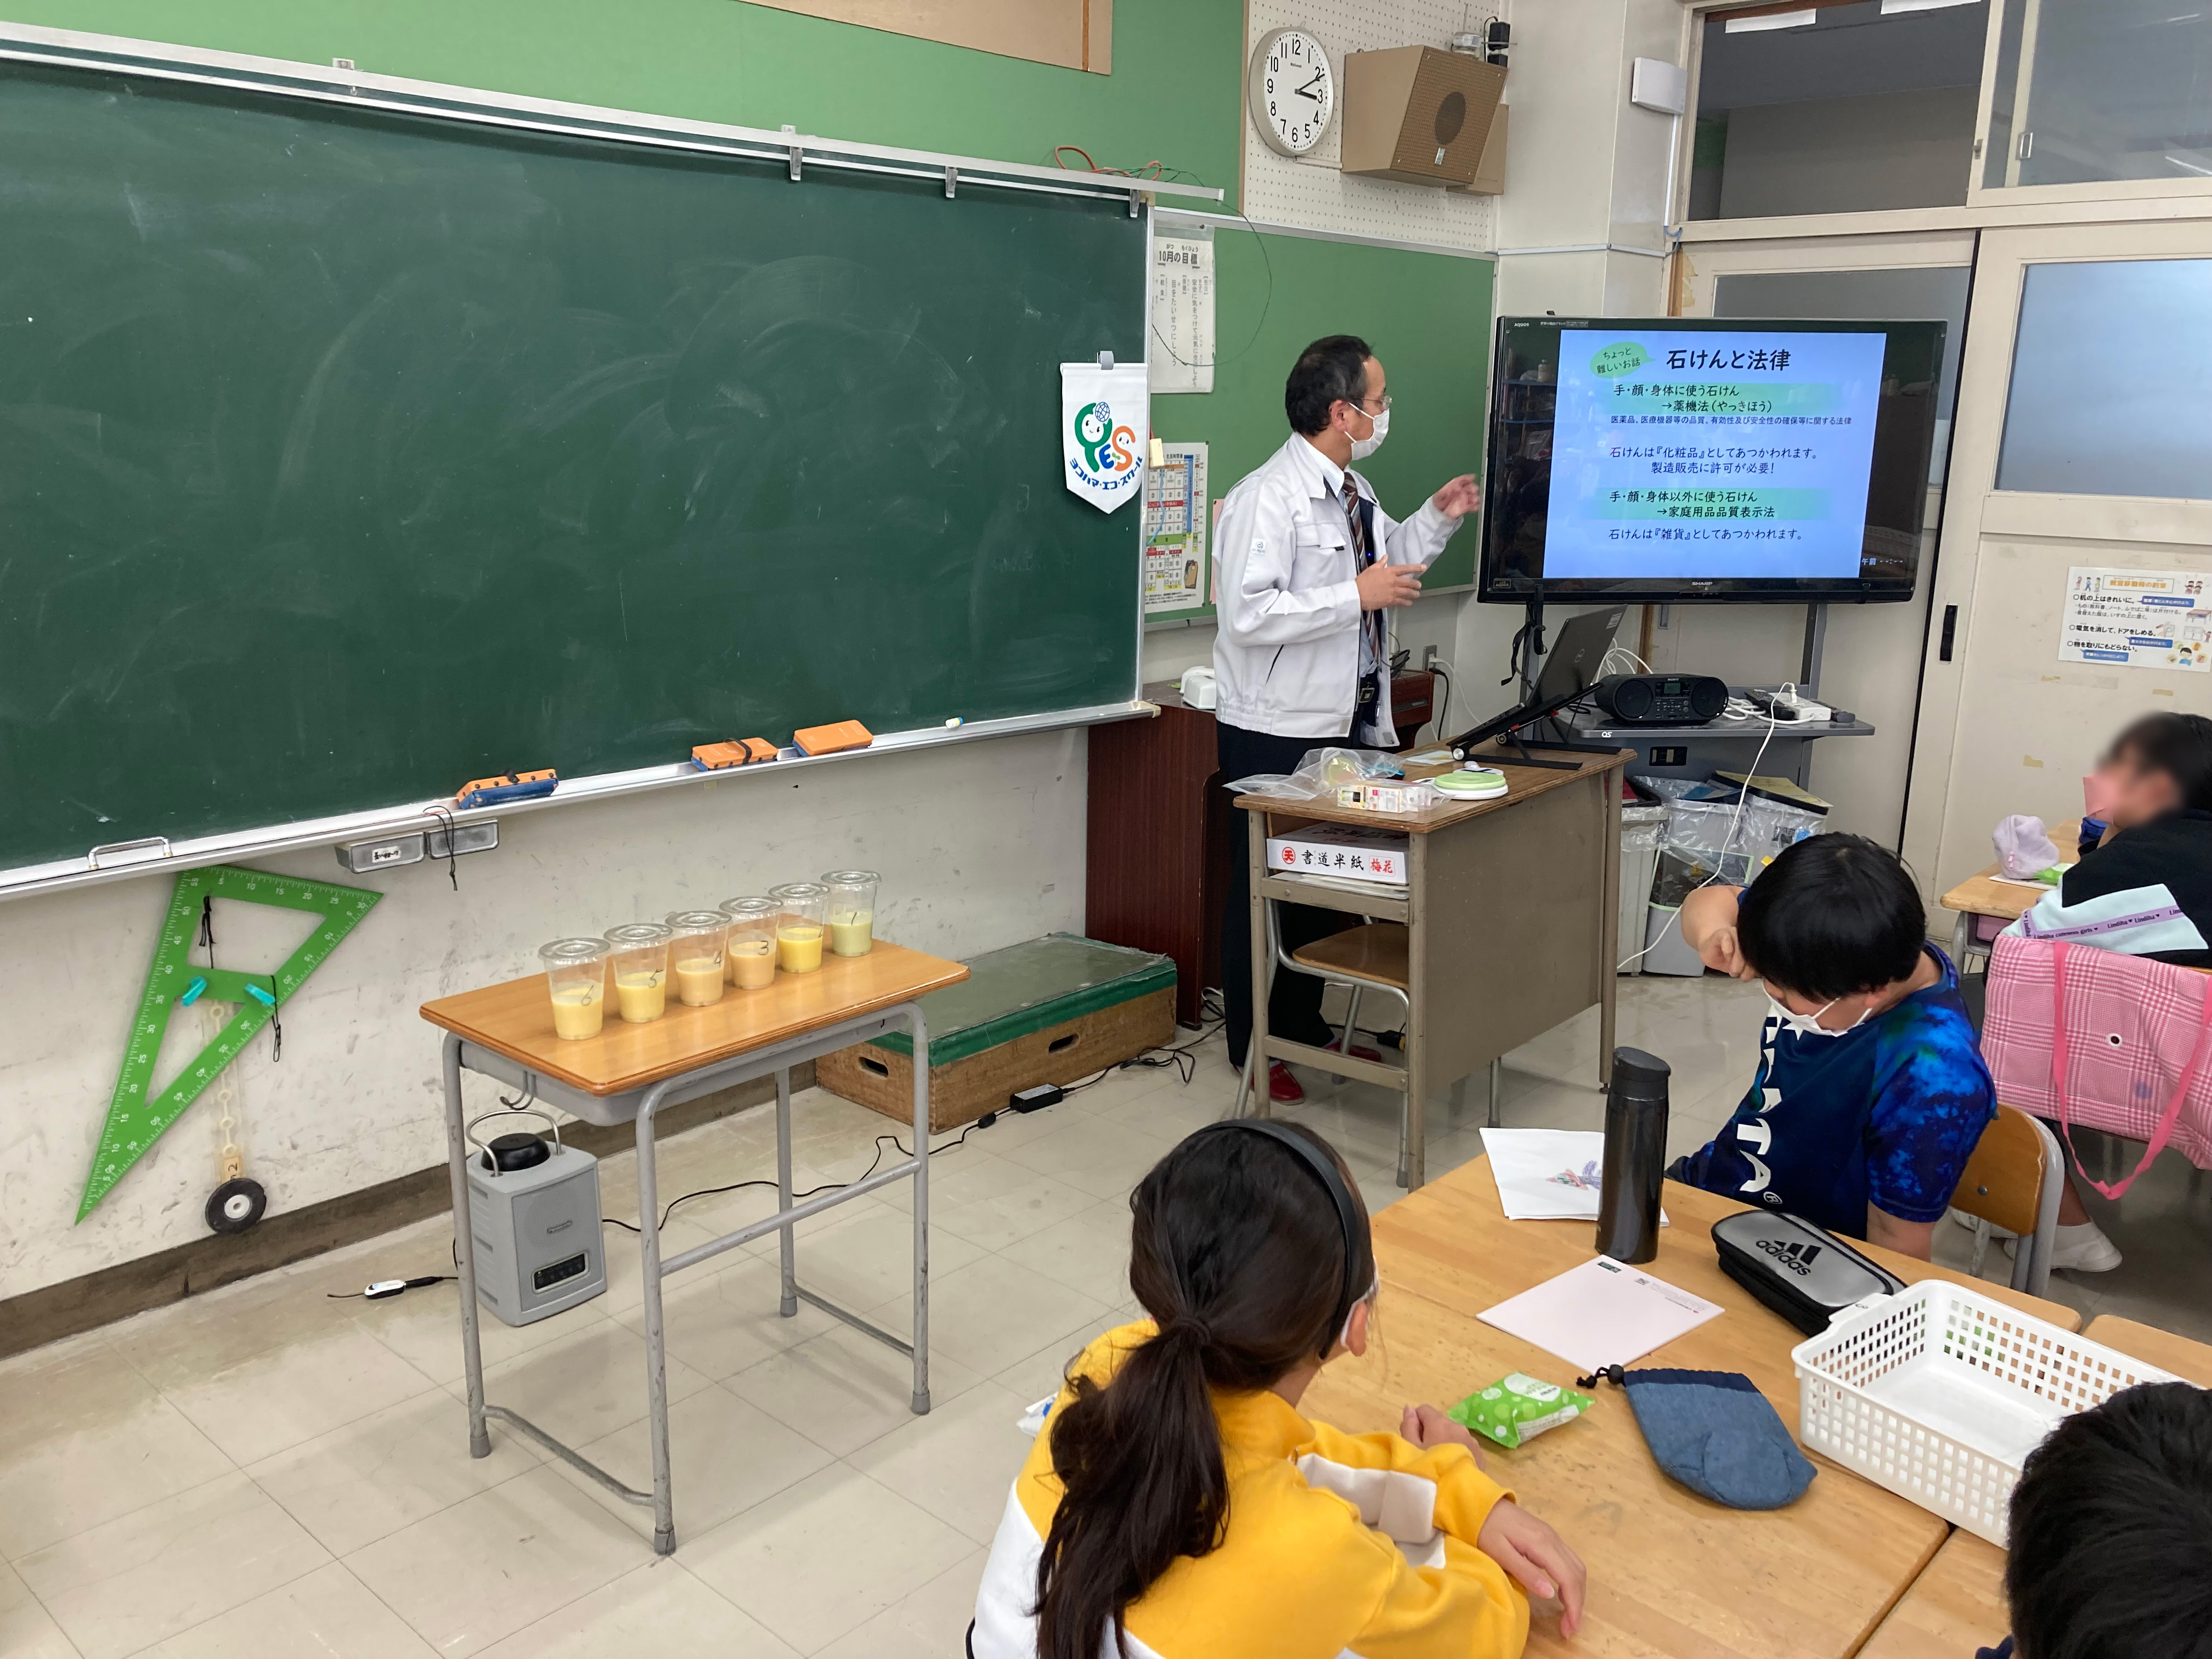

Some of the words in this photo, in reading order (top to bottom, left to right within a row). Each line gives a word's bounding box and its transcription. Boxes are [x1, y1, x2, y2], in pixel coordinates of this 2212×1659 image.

[1281, 42, 1287, 59] 11
[1292, 38, 1301, 55] 12
[1308, 48, 1310, 64] 1
[1271, 55, 1278, 72] 10
[1315, 66, 1320, 82] 2
[1267, 78, 1273, 94] 9
[1317, 89, 1323, 104] 3
[1270, 101, 1276, 116] 8
[1313, 110, 1319, 125] 4
[1280, 119, 1286, 135] 7
[1305, 123, 1310, 139] 5
[1292, 127, 1298, 143] 6
[1602, 347, 1632, 360] ちょっと
[1666, 348, 1791, 371] 石けんと法律
[1596, 357, 1640, 375] 難しいお話
[1613, 384, 1739, 397] 手・顔・身体に使う石けん
[1610, 446, 1817, 460] 石けんは『化粧品』としてあつかわれます。
[1070, 456, 1143, 490] ヨコハマ・エコ・スクール
[1651, 462, 1774, 475] 製造販売に許可が必要！
[1609, 490, 1758, 503] 手・顔・身体以外に使う石けん
[1609, 528, 1803, 541] 石けんは『雑貨』としてあつかわれます。
[1861, 557, 1876, 566] 午前
[1301, 849, 1364, 871] 書道半紙
[1370, 857, 1393, 874] 梅花
[190, 877, 199, 887] 55
[182, 906, 190, 916] 50
[851, 911, 857, 926] 1
[173, 935, 182, 945] 45
[758, 940, 769, 956] 3
[304, 953, 313, 962] 15
[714, 950, 723, 968] 4
[165, 965, 173, 975] 40
[283, 975, 292, 984] 20
[648, 969, 664, 988] 5
[156, 995, 165, 1005] 35
[581, 985, 594, 1006] 6
[146, 1024, 156, 1034] 30
[240, 1020, 250, 1030] 30
[218, 1043, 228, 1053] 35
[138, 1054, 147, 1064] 25
[196, 1068, 205, 1077] 40
[129, 1084, 138, 1093] 20
[173, 1092, 183, 1101] 45
[120, 1113, 129, 1123] 15
[150, 1116, 160, 1126] 50
[111, 1143, 120, 1153] 10
[127, 1141, 137, 1150] 55
[1756, 1240, 1811, 1276] adidas
